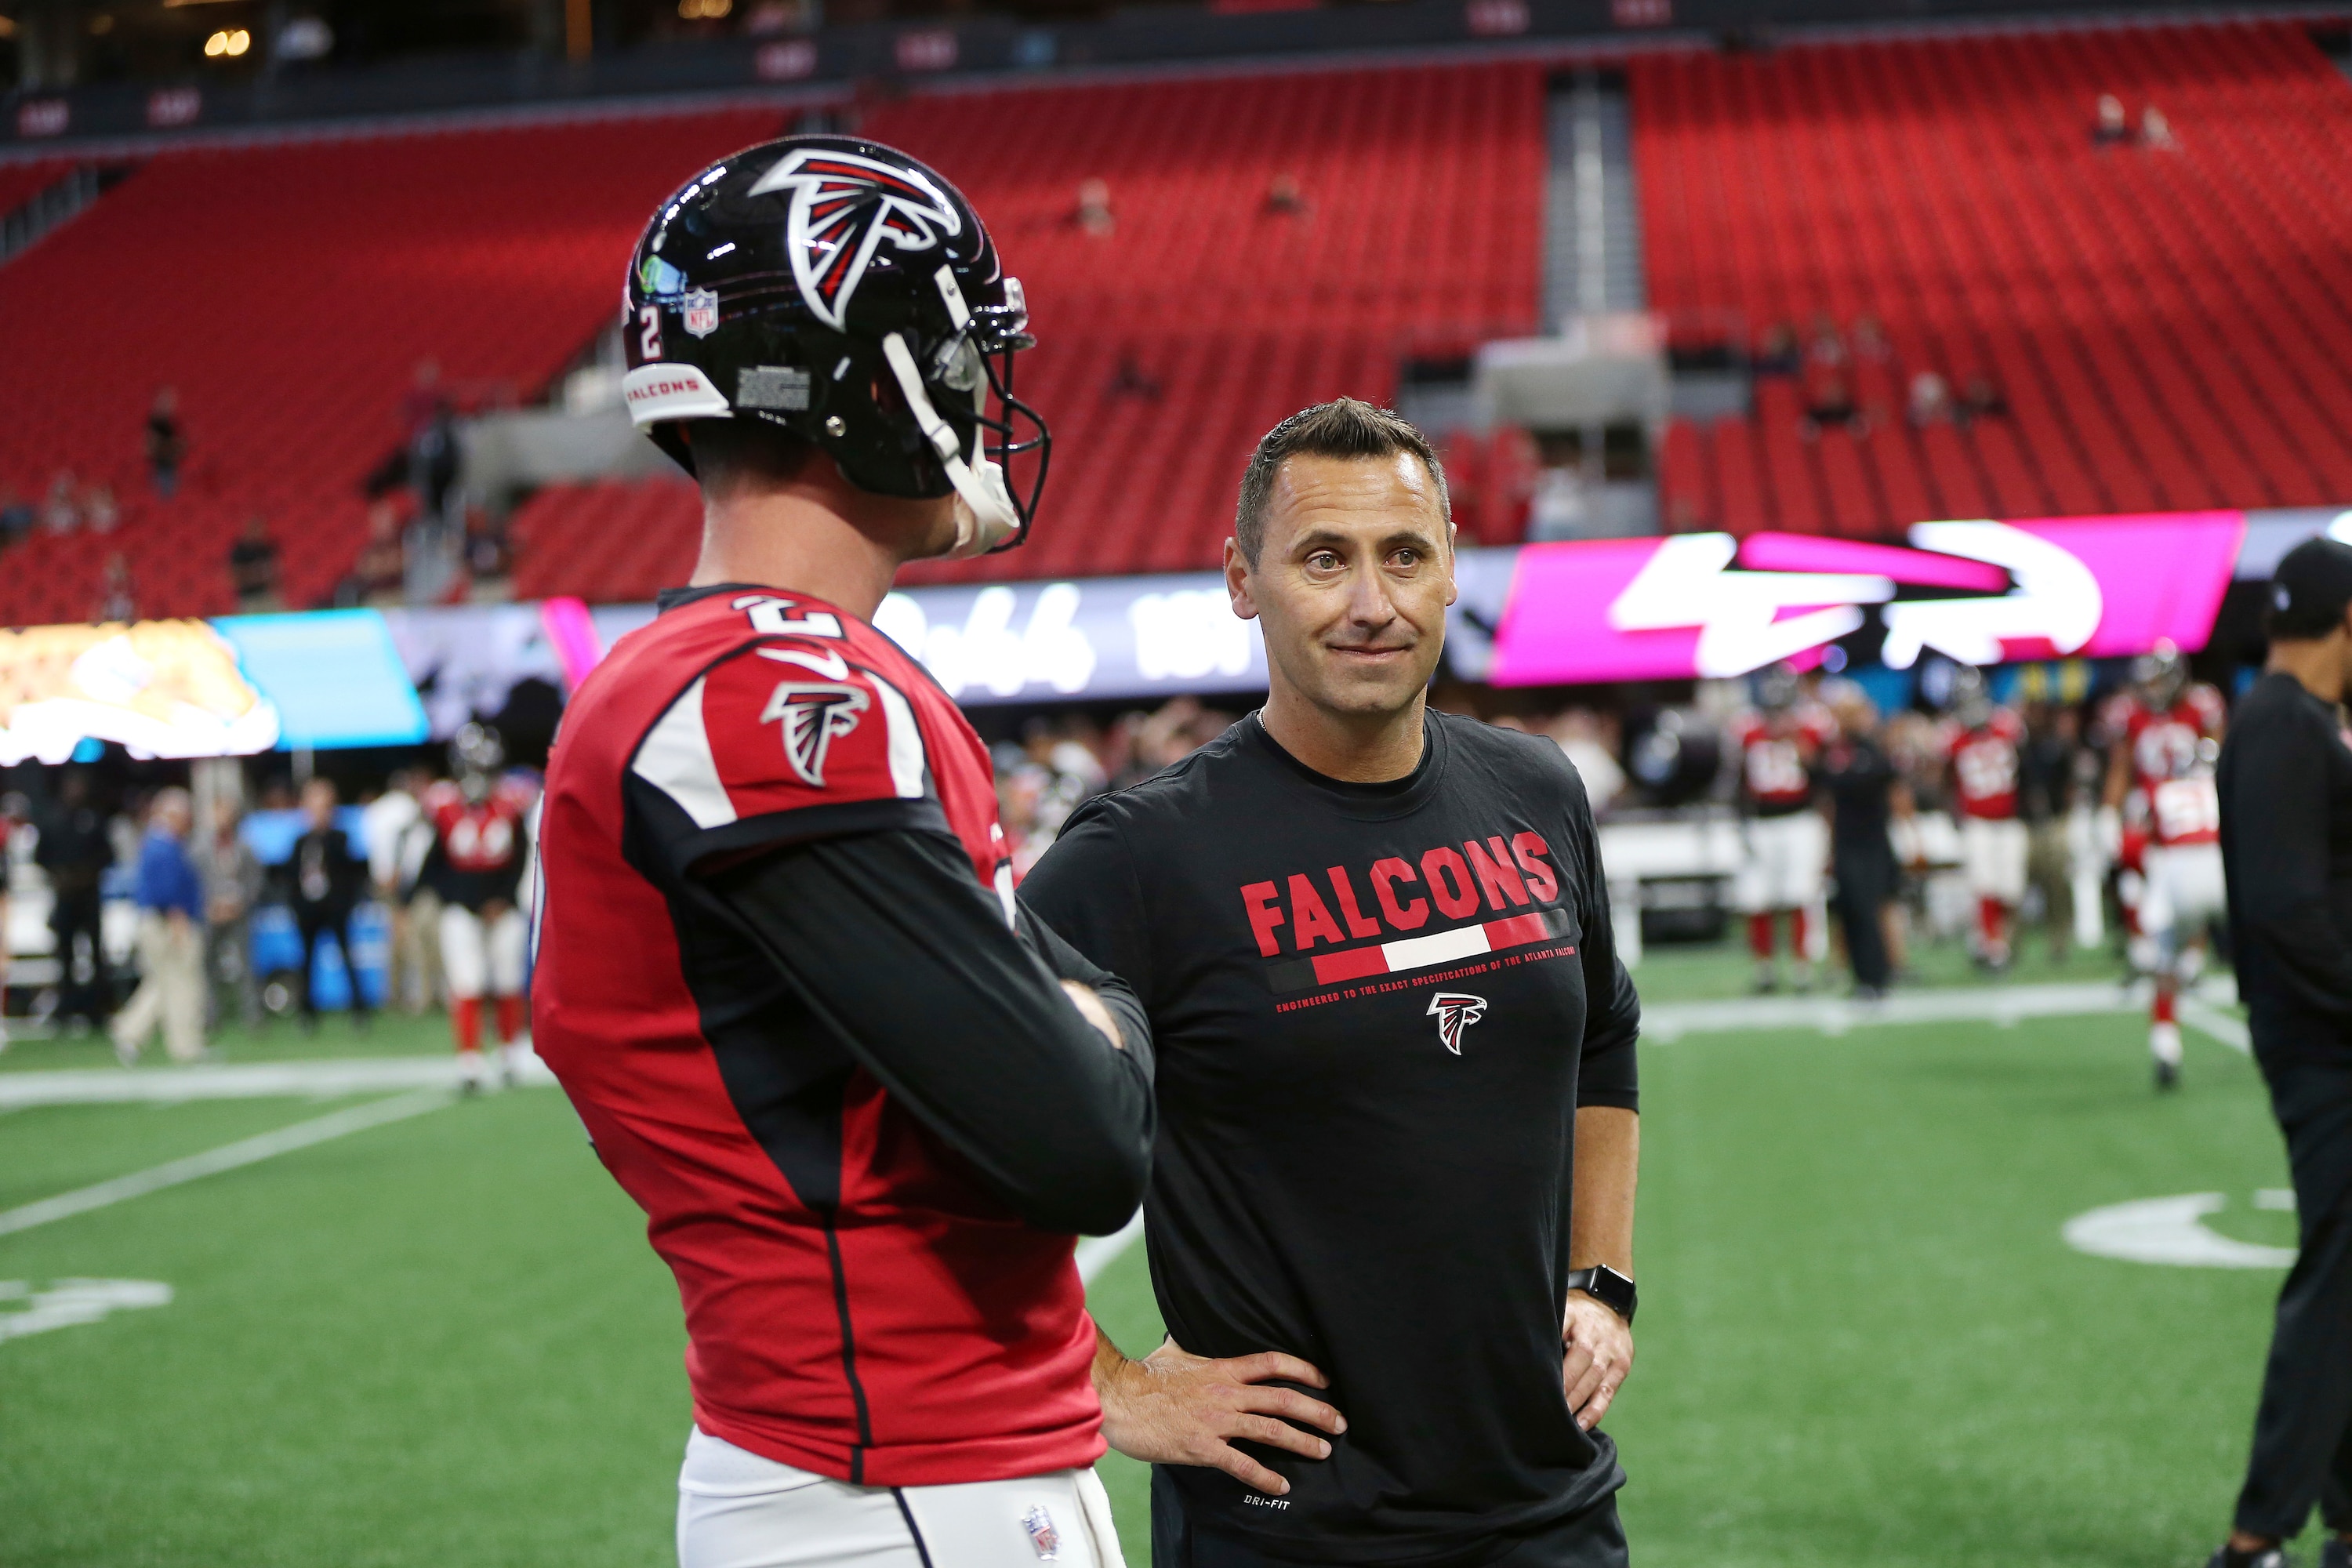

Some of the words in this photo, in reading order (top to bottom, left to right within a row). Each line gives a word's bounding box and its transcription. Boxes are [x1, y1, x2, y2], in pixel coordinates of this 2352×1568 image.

[640, 305, 662, 361] 2
[689, 309, 713, 328] NFL
[731, 595, 845, 639] 2
[1240, 831, 1559, 957] FALCONS
[1276, 993, 1340, 1014] ENGINEERED
[1343, 989, 1356, 999] TO
[1359, 985, 1377, 996] THE
[1379, 979, 1409, 993] EXACT
[1411, 963, 1488, 987] SPECIFICATIONS
[1490, 960, 1502, 971] OF
[1504, 955, 1522, 967] THE
[1524, 949, 1555, 963] ATLANTA
[1243, 1494, 1290, 1511] DRI-FIT
